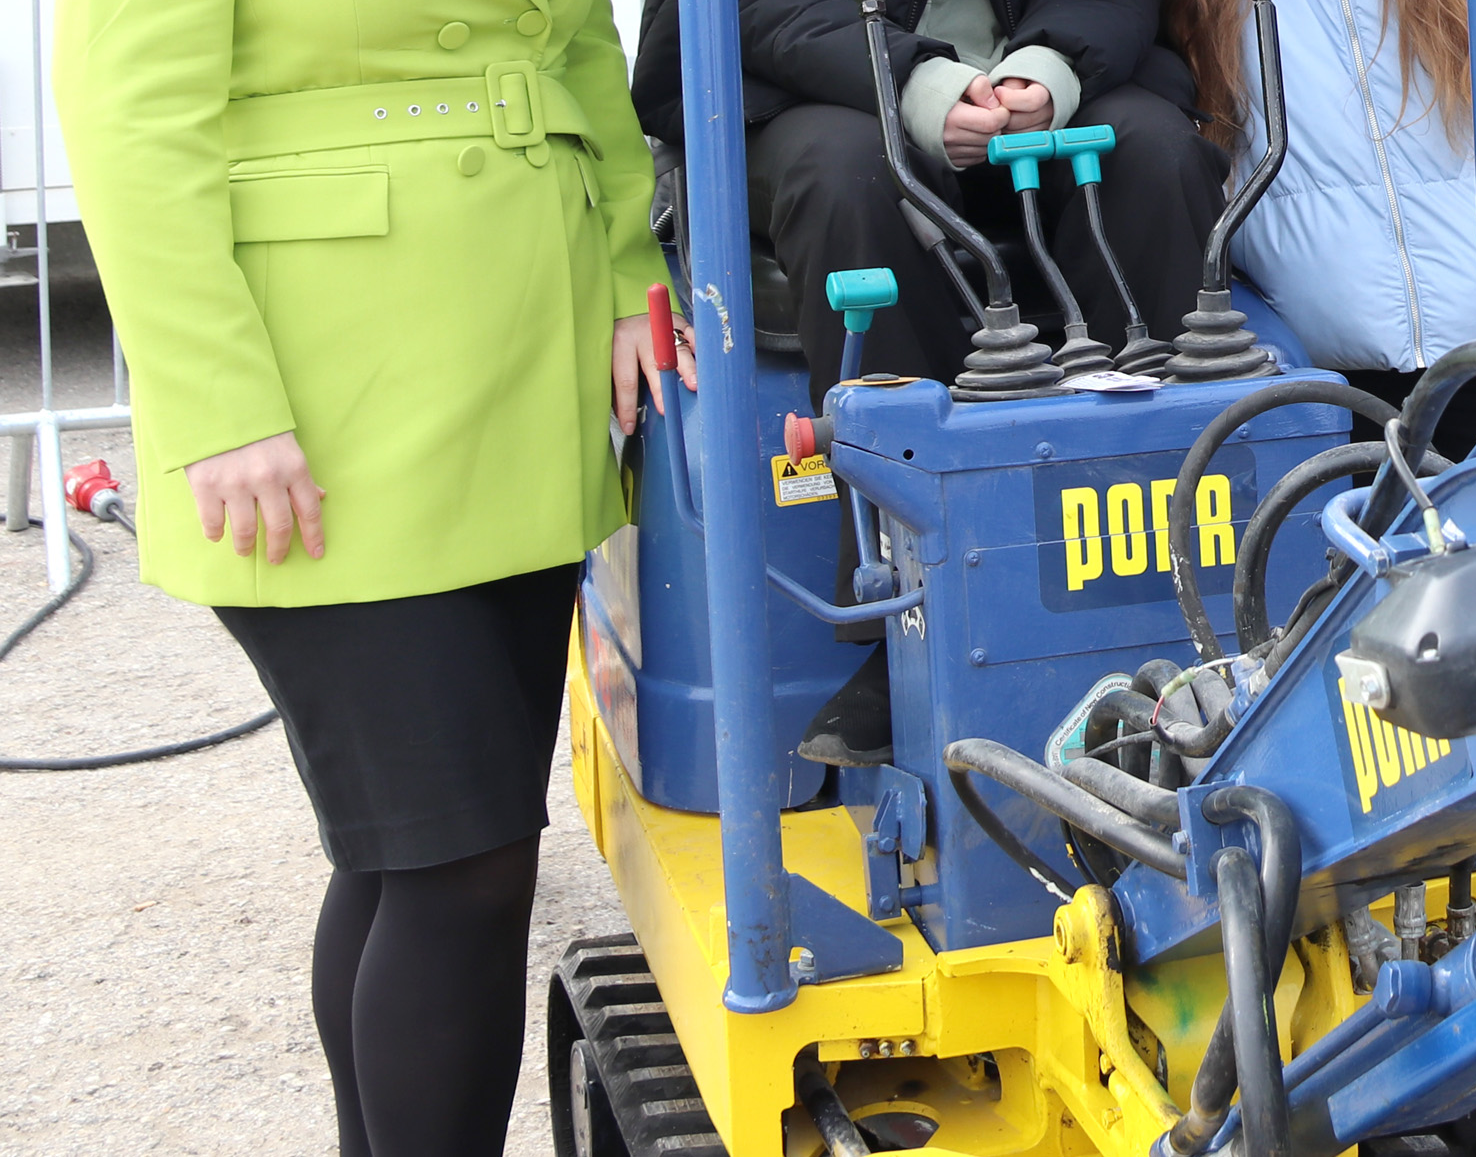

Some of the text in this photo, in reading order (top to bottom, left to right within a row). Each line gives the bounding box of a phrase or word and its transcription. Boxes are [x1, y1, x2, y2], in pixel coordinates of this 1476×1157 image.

[1055, 716, 1082, 746] Certificate
[1080, 708, 1087, 718] of
[1085, 698, 1098, 711] New
